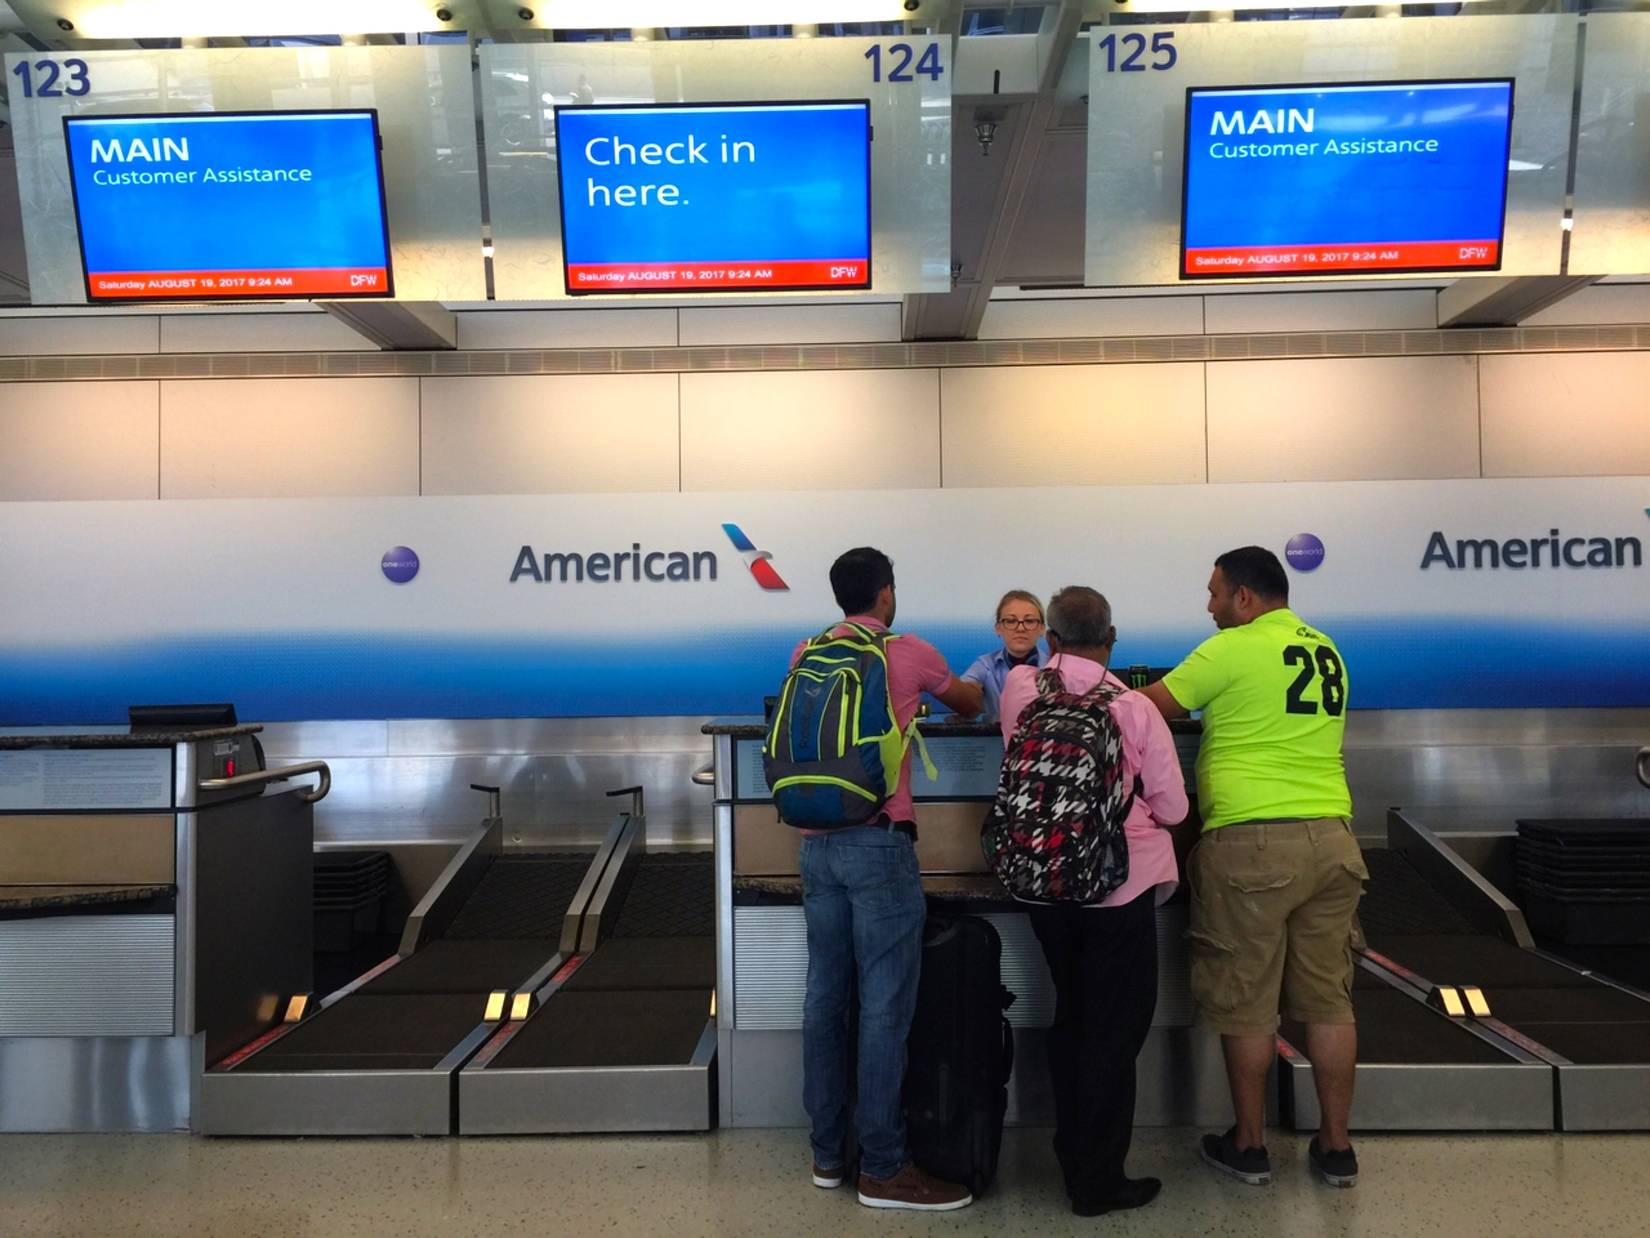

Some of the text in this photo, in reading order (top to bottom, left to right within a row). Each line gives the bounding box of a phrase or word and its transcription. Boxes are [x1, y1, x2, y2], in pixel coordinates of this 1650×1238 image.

[864, 42, 944, 82] 124
[1098, 31, 1177, 72] 125
[13, 58, 91, 97] 123
[1210, 108, 1314, 135] MAIN
[91, 137, 189, 163] MAIN
[585, 134, 755, 166] Check in
[1210, 138, 1439, 159] Customer Assistance
[93, 167, 312, 185] Customer Assistance
[588, 178, 689, 206] here.
[1195, 256, 1244, 266] Saturday
[1248, 254, 1298, 264] AUGUST
[1322, 253, 1349, 262] 2017
[1352, 252, 1377, 261] 9:24
[1379, 251, 1398, 260] AM
[1459, 247, 1488, 259] DFW
[99, 280, 145, 290] Saturday
[148, 279, 197, 288] AUGUST
[219, 278, 245, 287] 2017
[248, 278, 272, 287] 9:24
[275, 277, 293, 286] AM
[351, 274, 377, 287] DFW
[578, 272, 625, 282] Saturday
[628, 271, 676, 280] AUGUST
[699, 270, 725, 279] 2017
[728, 270, 751, 279] 9:24
[754, 269, 772, 278] AM
[831, 267, 857, 279] DFW
[1420, 529, 1642, 569] American
[509, 543, 717, 583] American
[1282, 645, 1344, 716] 28
